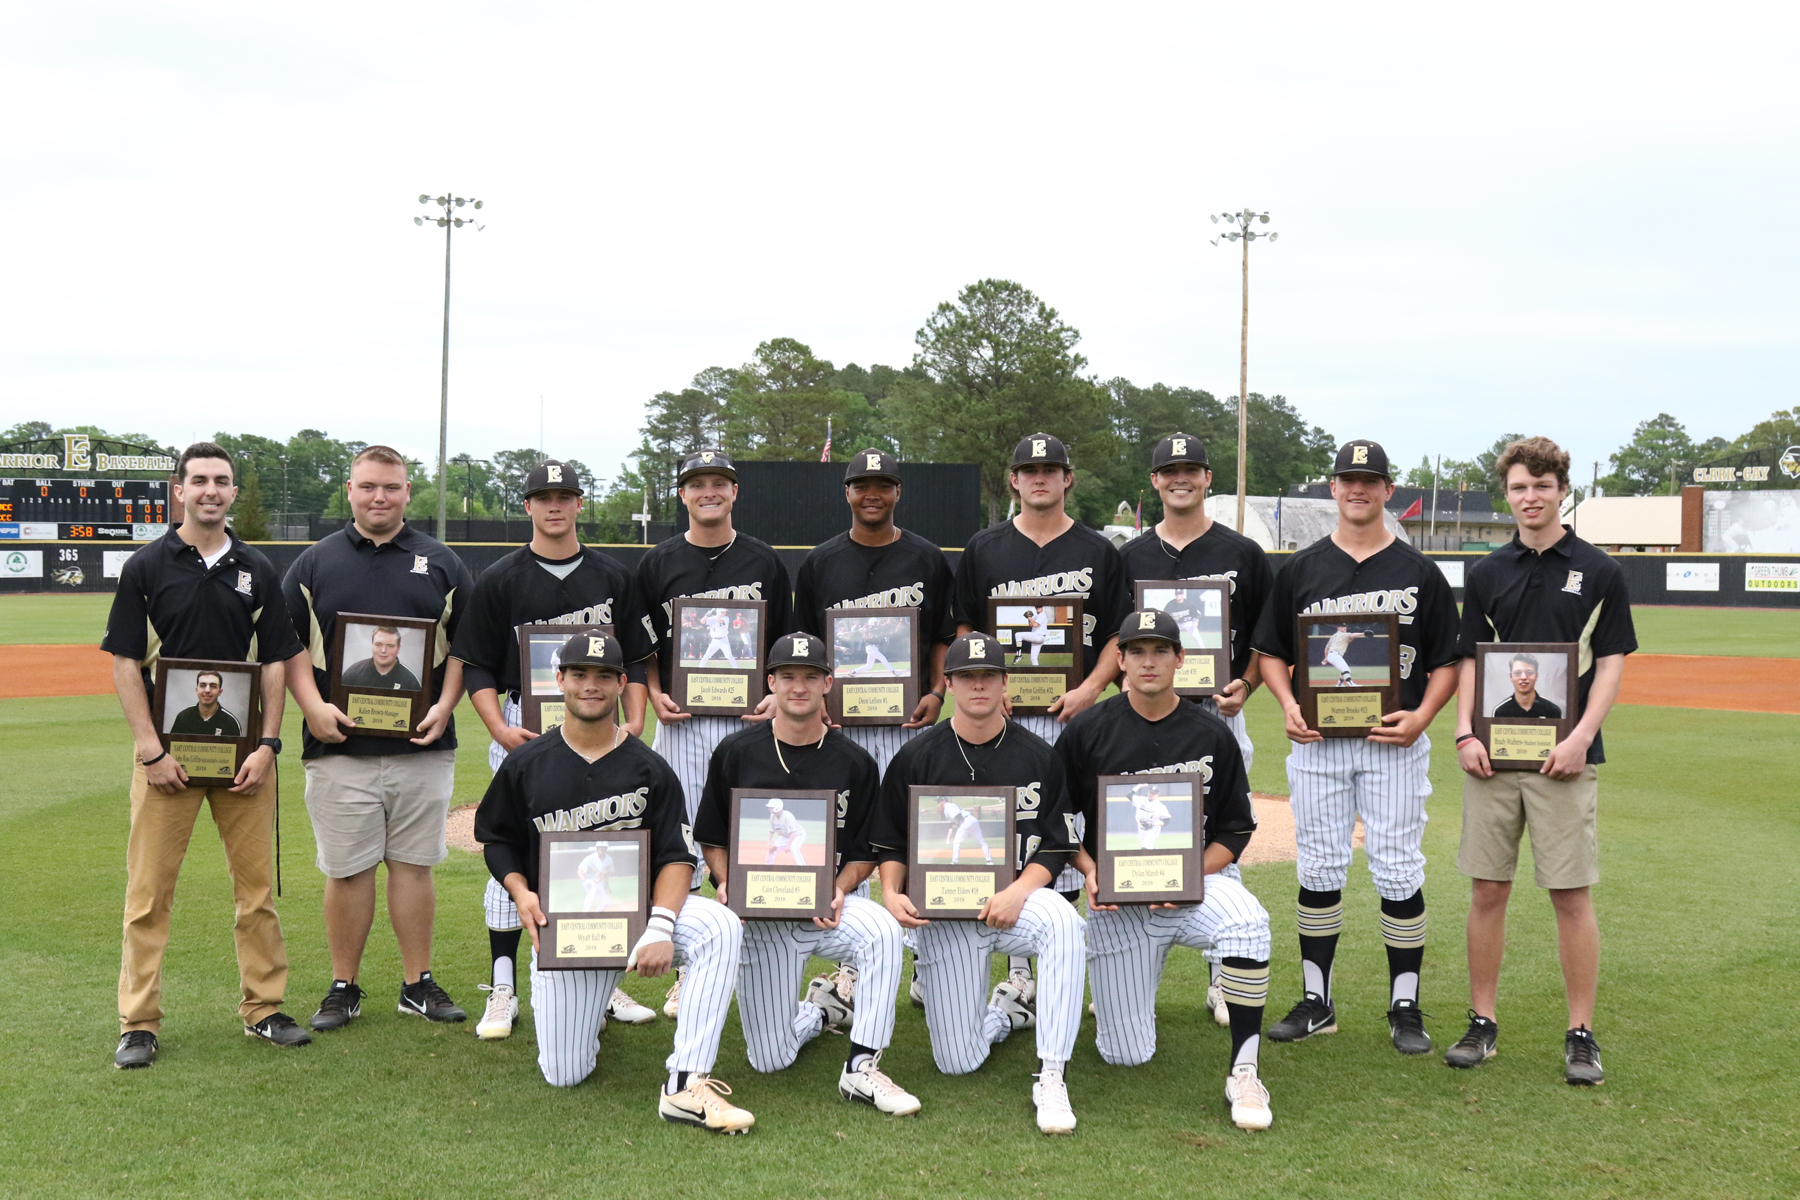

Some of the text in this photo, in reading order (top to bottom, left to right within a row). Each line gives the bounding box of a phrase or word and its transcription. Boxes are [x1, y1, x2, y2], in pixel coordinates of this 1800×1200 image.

[0, 453, 61, 469] RRIOR
[96, 453, 175, 471] BASEBALL
[41, 486, 48, 497] 0
[80, 487, 87, 497] 0
[115, 487, 122, 498] 0
[126, 504, 162, 513] 0 0 0
[126, 514, 162, 523] 0 0 0
[70, 526, 93, 537] 3:58
[59, 549, 78, 561] 365
[1748, 580, 1798, 588] OUTDOORS
[533, 787, 649, 833] WARRIORS
